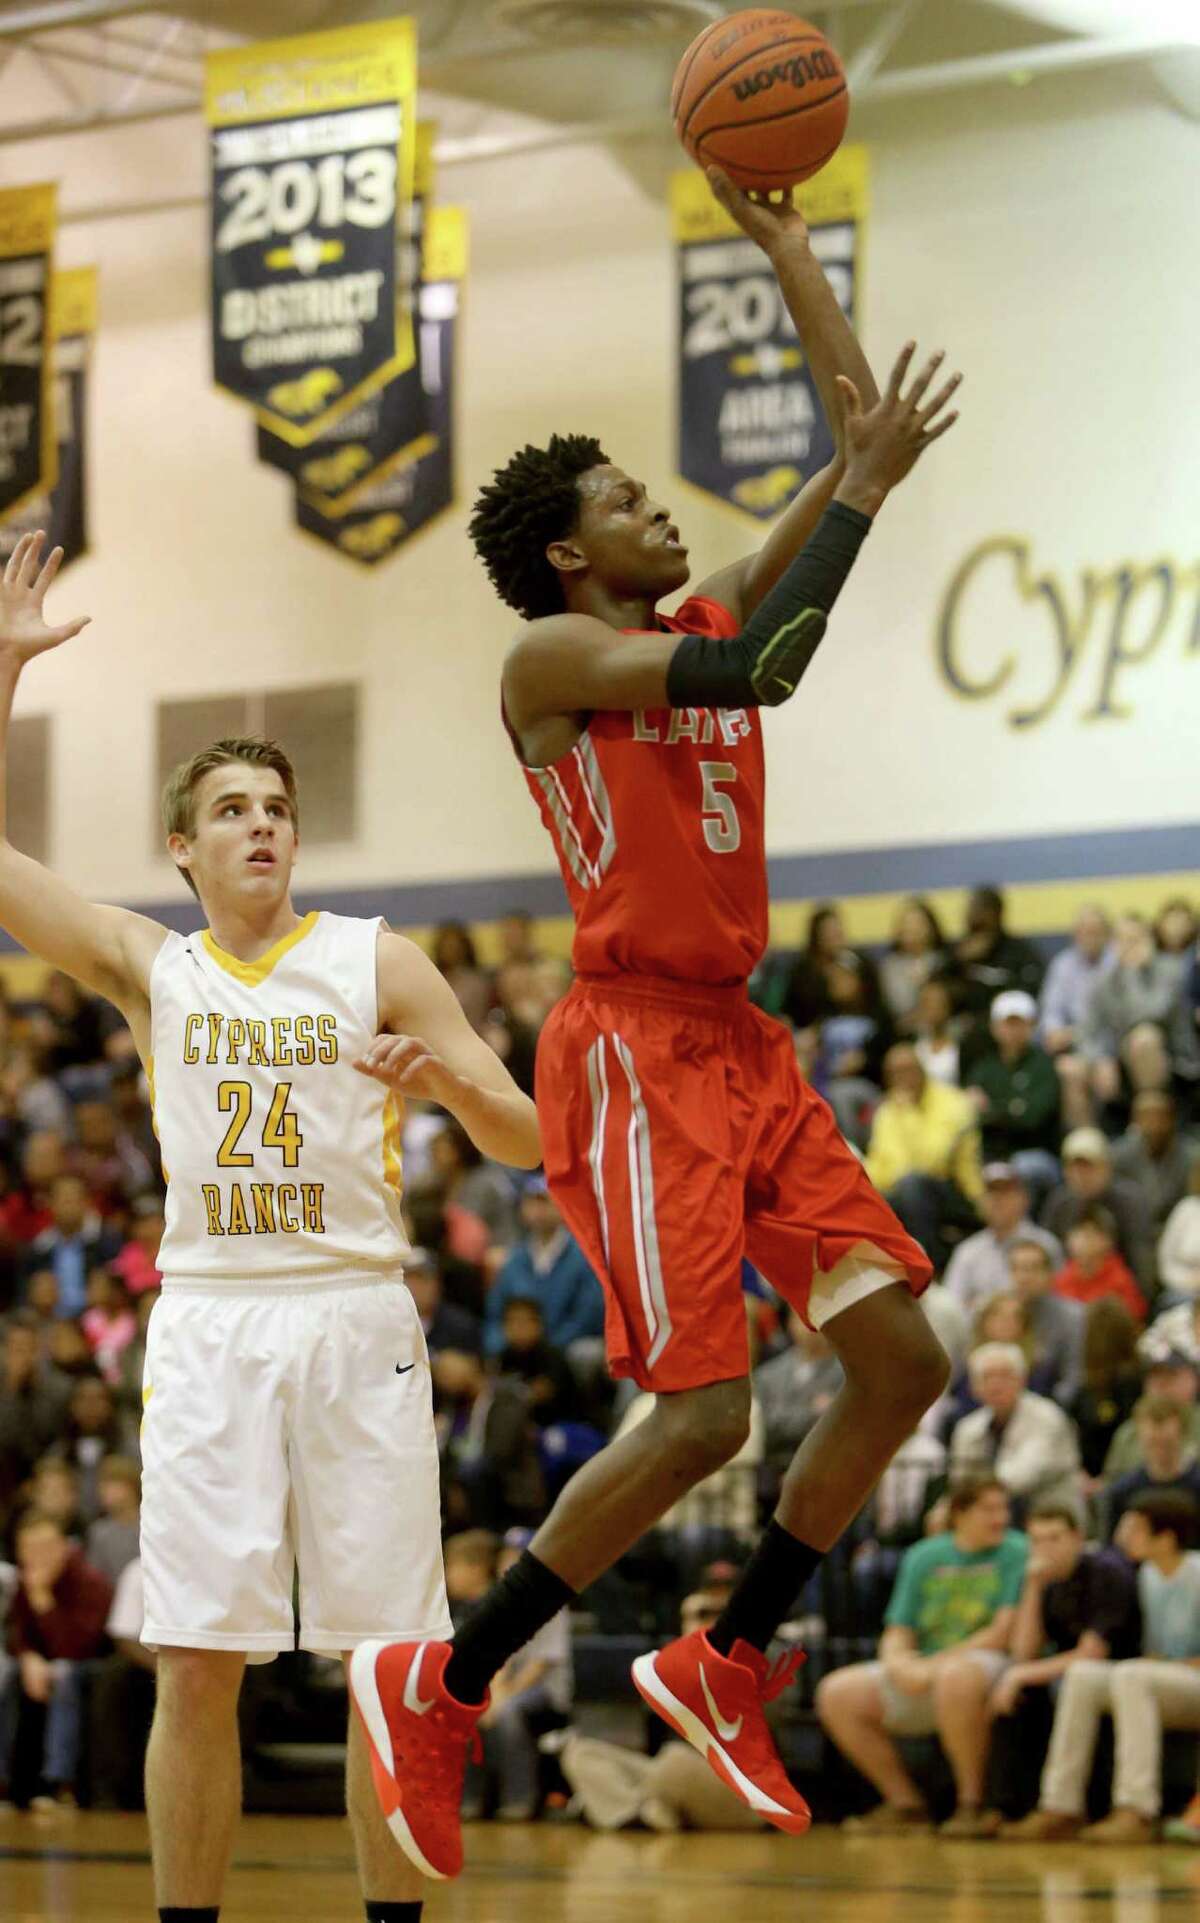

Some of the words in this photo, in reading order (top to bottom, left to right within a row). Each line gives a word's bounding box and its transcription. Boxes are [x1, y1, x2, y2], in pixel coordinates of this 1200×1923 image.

[732, 47, 840, 101] Wilson
[216, 148, 398, 254] 2013
[698, 760, 741, 854] 5
[183, 1012, 339, 1066] CYPRESS
[216, 1081, 304, 1168] 24
[201, 1183, 326, 1235] RANCH
